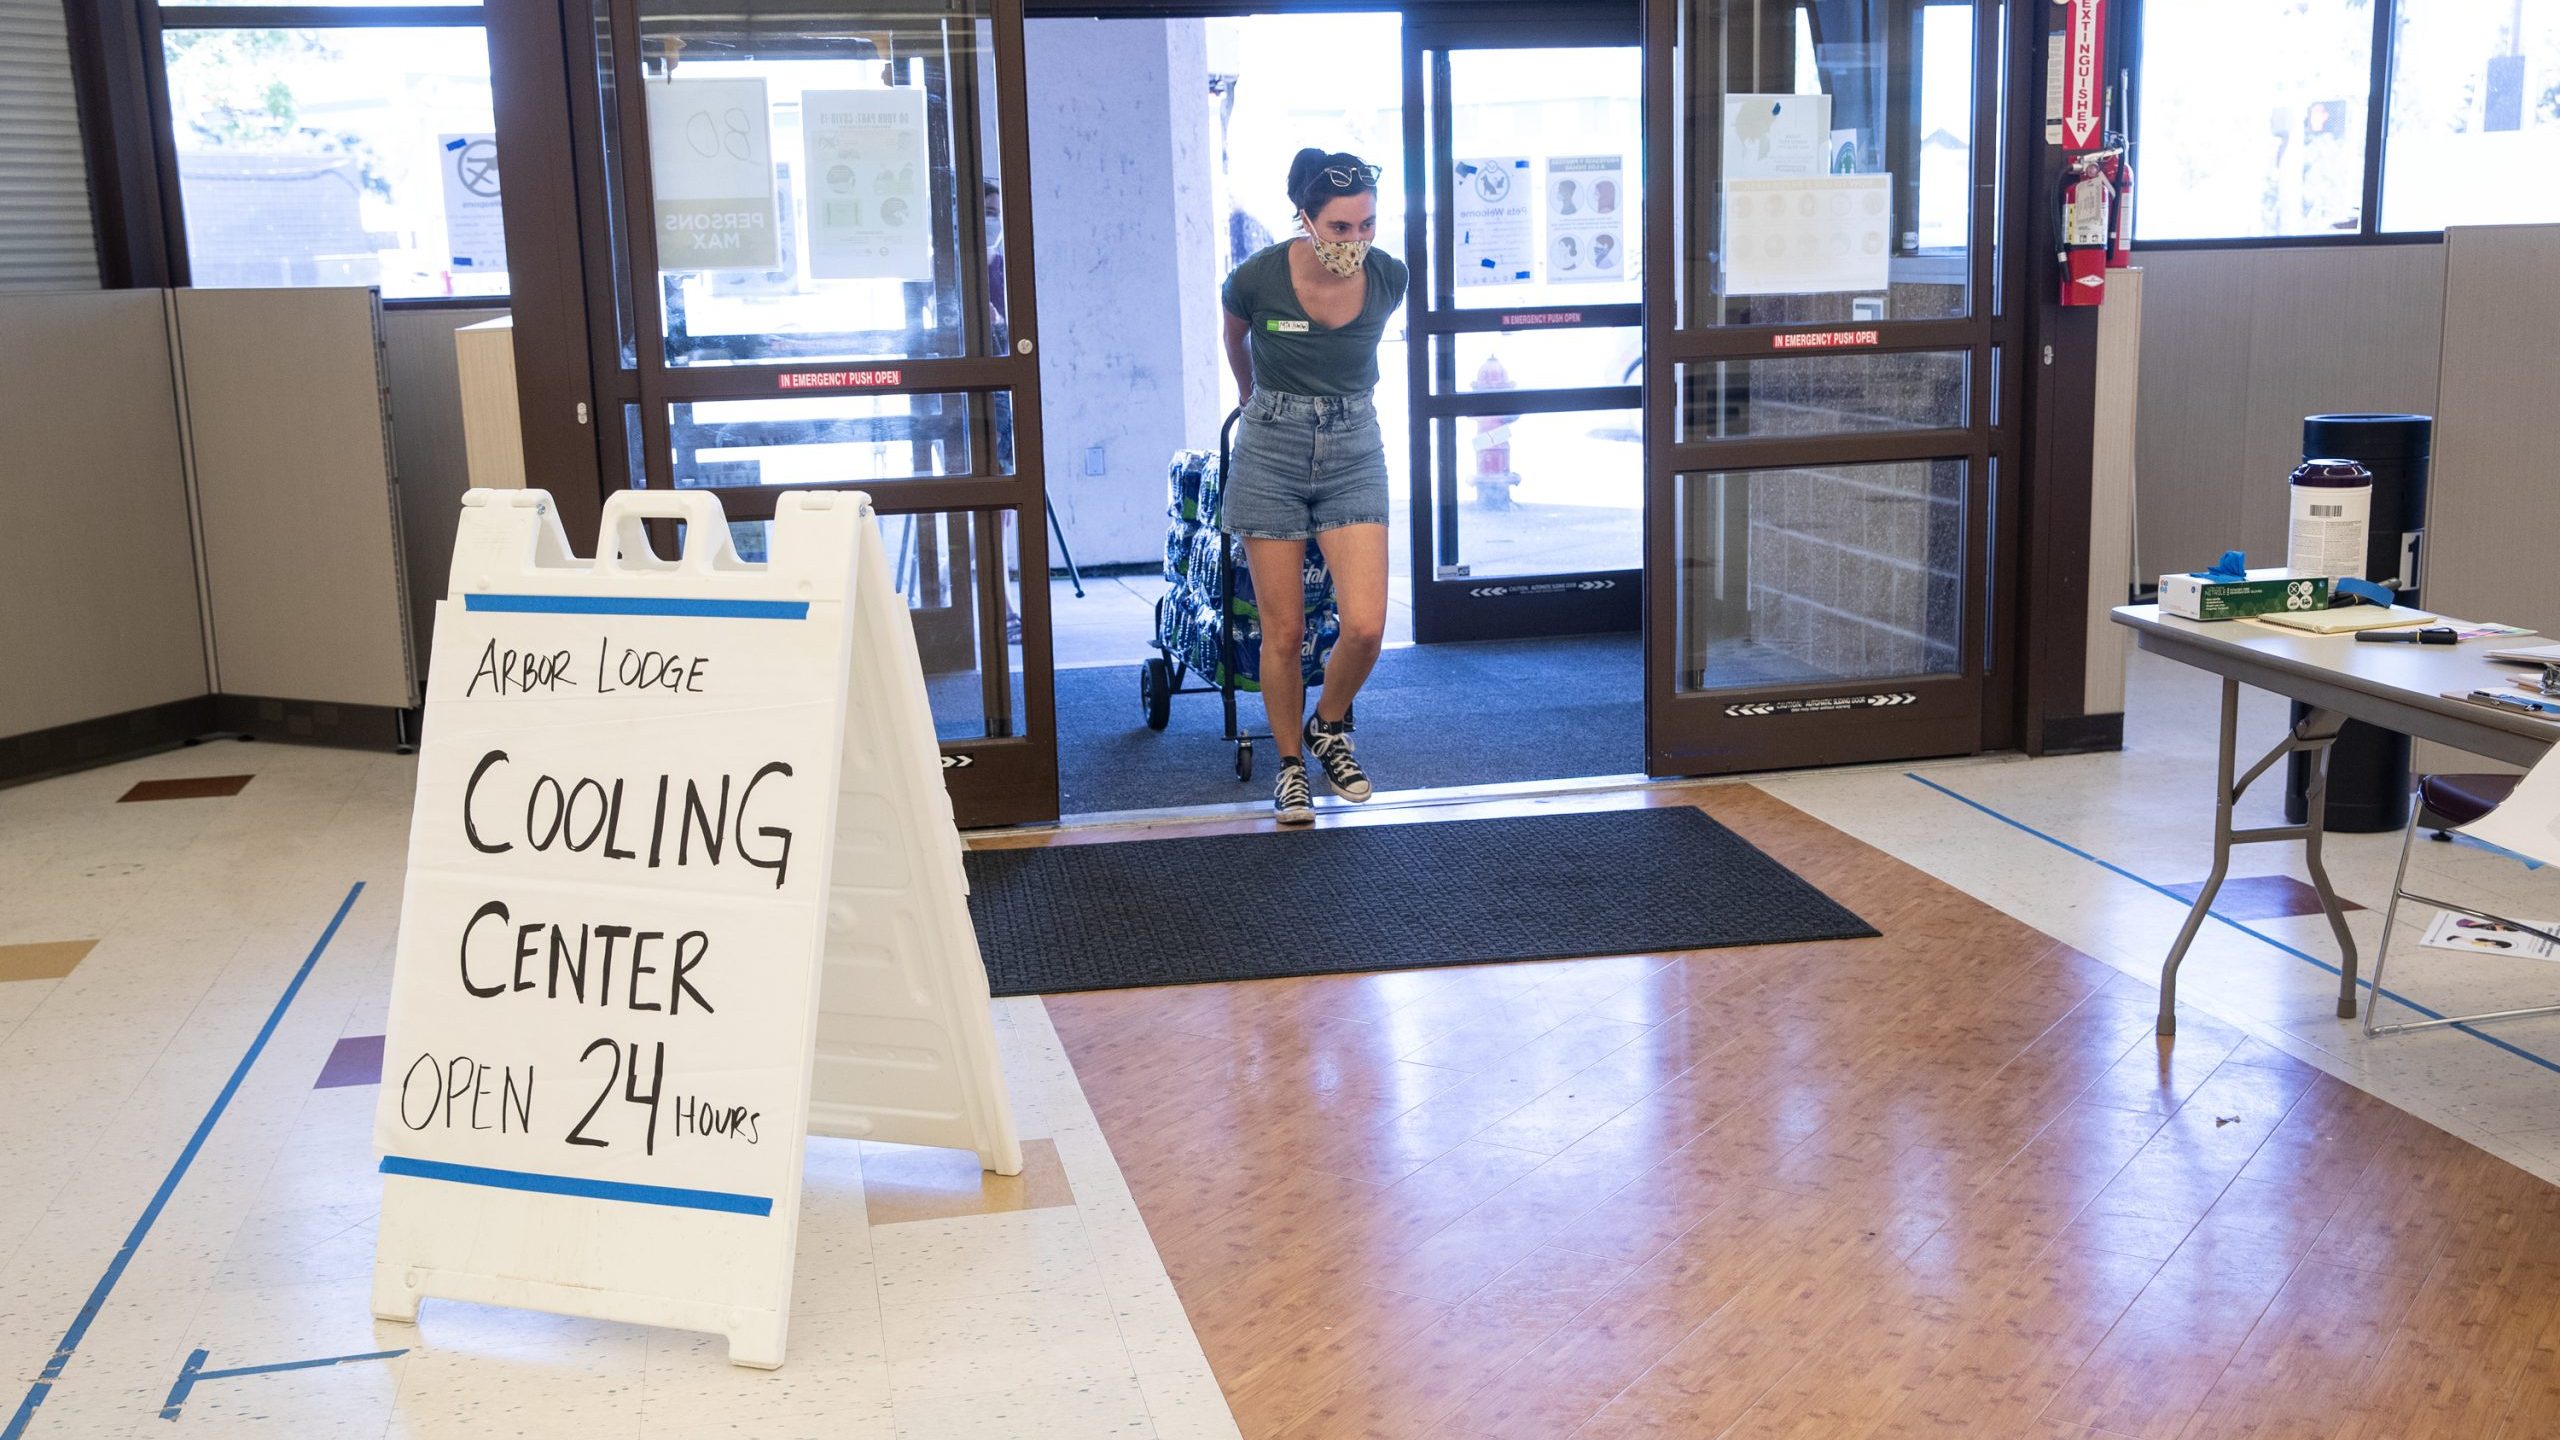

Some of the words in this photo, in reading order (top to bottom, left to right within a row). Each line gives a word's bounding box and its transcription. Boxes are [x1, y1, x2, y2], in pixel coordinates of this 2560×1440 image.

[2076, 0, 2092, 132] EXTINGUISHER
[1511, 314, 1547, 325] EMERGENCY
[1547, 313, 1564, 323] PUSH
[1774, 335, 1783, 347] IN
[1784, 333, 1832, 347] EMERGENCY
[1833, 332, 1854, 345] PUSH
[1855, 331, 1877, 344] OPEN
[780, 374, 790, 387] IN
[792, 372, 847, 387] EMERGENCY
[848, 371, 873, 385] PUSH
[874, 370, 899, 384] OPEN
[2407, 534, 2420, 588] 1
[466, 637, 577, 698] ARBOR
[598, 636, 709, 694] LODGE
[464, 749, 793, 890] COOLING
[460, 900, 715, 1016] CENTER
[401, 1052, 534, 1134] OPEN
[564, 1037, 665, 1156] 24
[676, 1095, 760, 1143] HOURS
